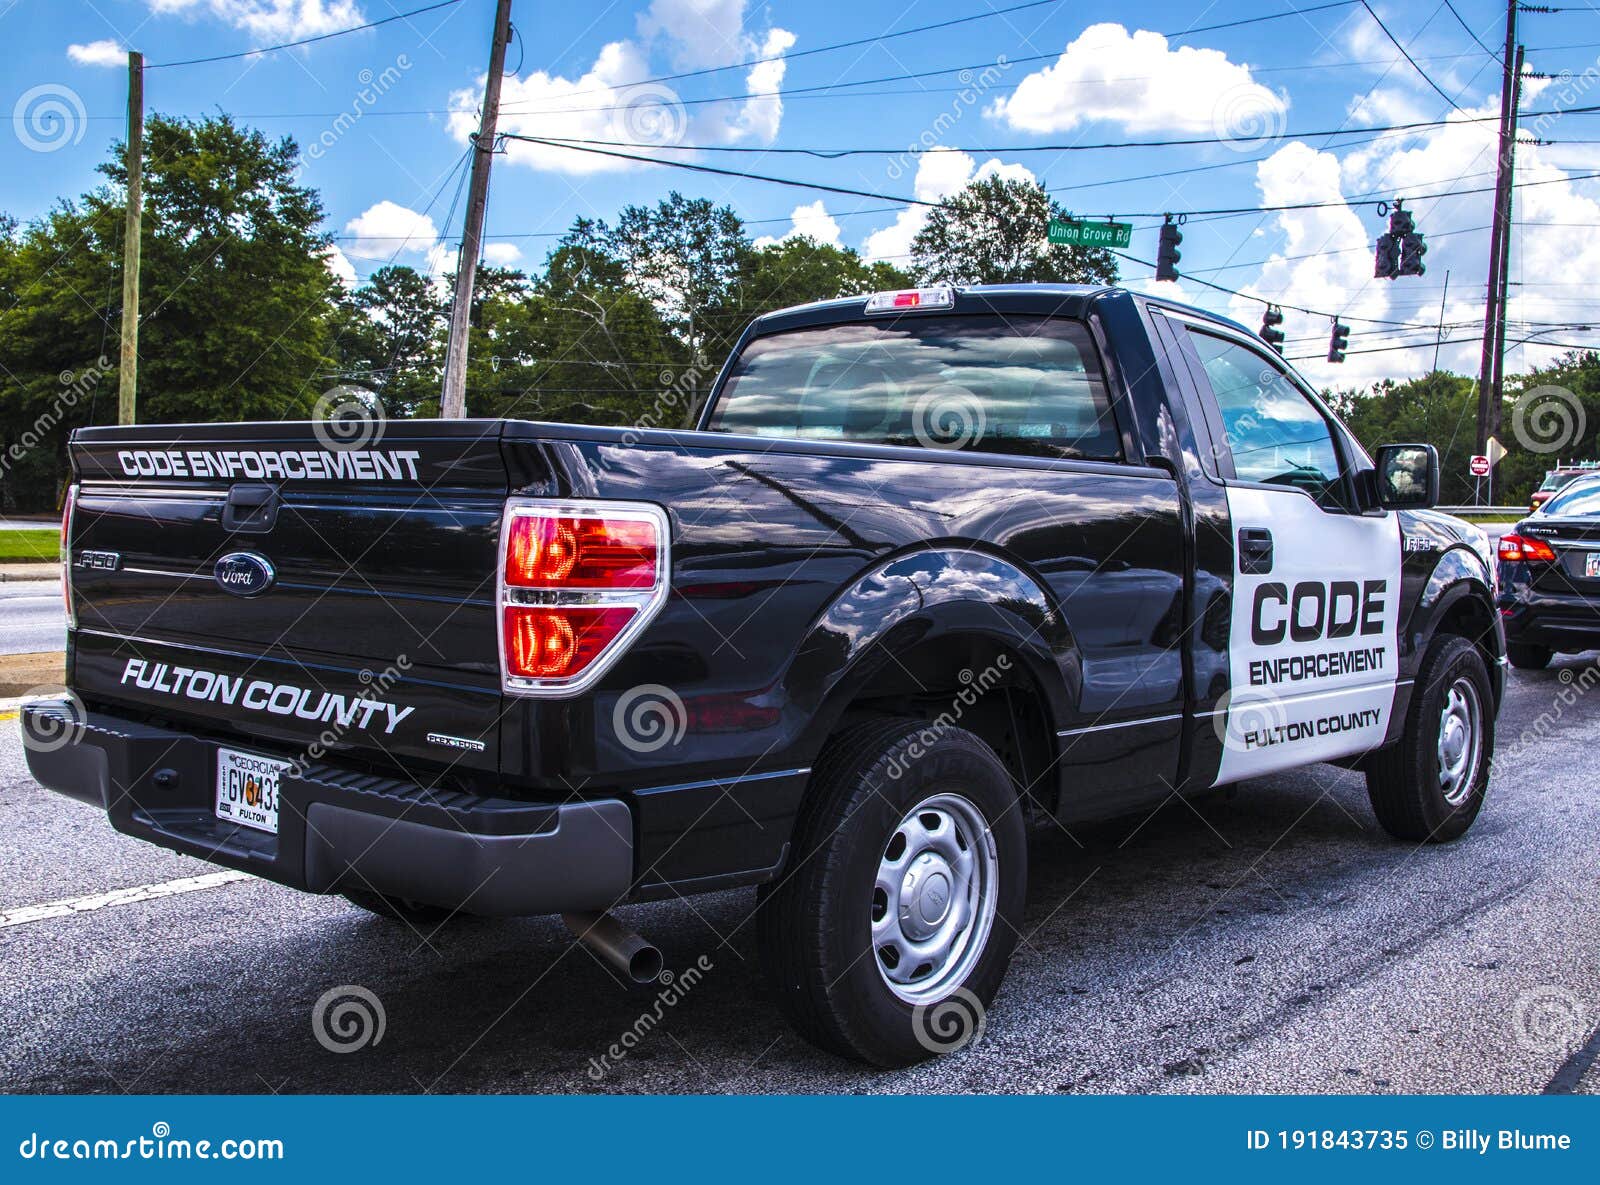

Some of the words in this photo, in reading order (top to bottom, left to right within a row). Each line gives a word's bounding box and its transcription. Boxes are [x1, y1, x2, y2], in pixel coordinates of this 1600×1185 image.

[1050, 225, 1079, 239] Union
[1083, 227, 1113, 241] Grove
[1116, 229, 1130, 242] Rd
[117, 450, 187, 477] CODE
[190, 450, 421, 480] ENFORCEMENT
[221, 560, 254, 585] Ford
[1251, 579, 1387, 646] CODE
[1249, 647, 1385, 686] ENFORCEMENT
[120, 658, 244, 702] FULTON
[242, 679, 415, 734] COUNTY
[429, 734, 451, 746] FLEX
[458, 740, 484, 752] FUEL
[1244, 719, 1315, 750] FULTON
[1317, 709, 1381, 736] COUNTY
[235, 755, 276, 777] GEORGIA
[239, 809, 267, 824] FULTON
